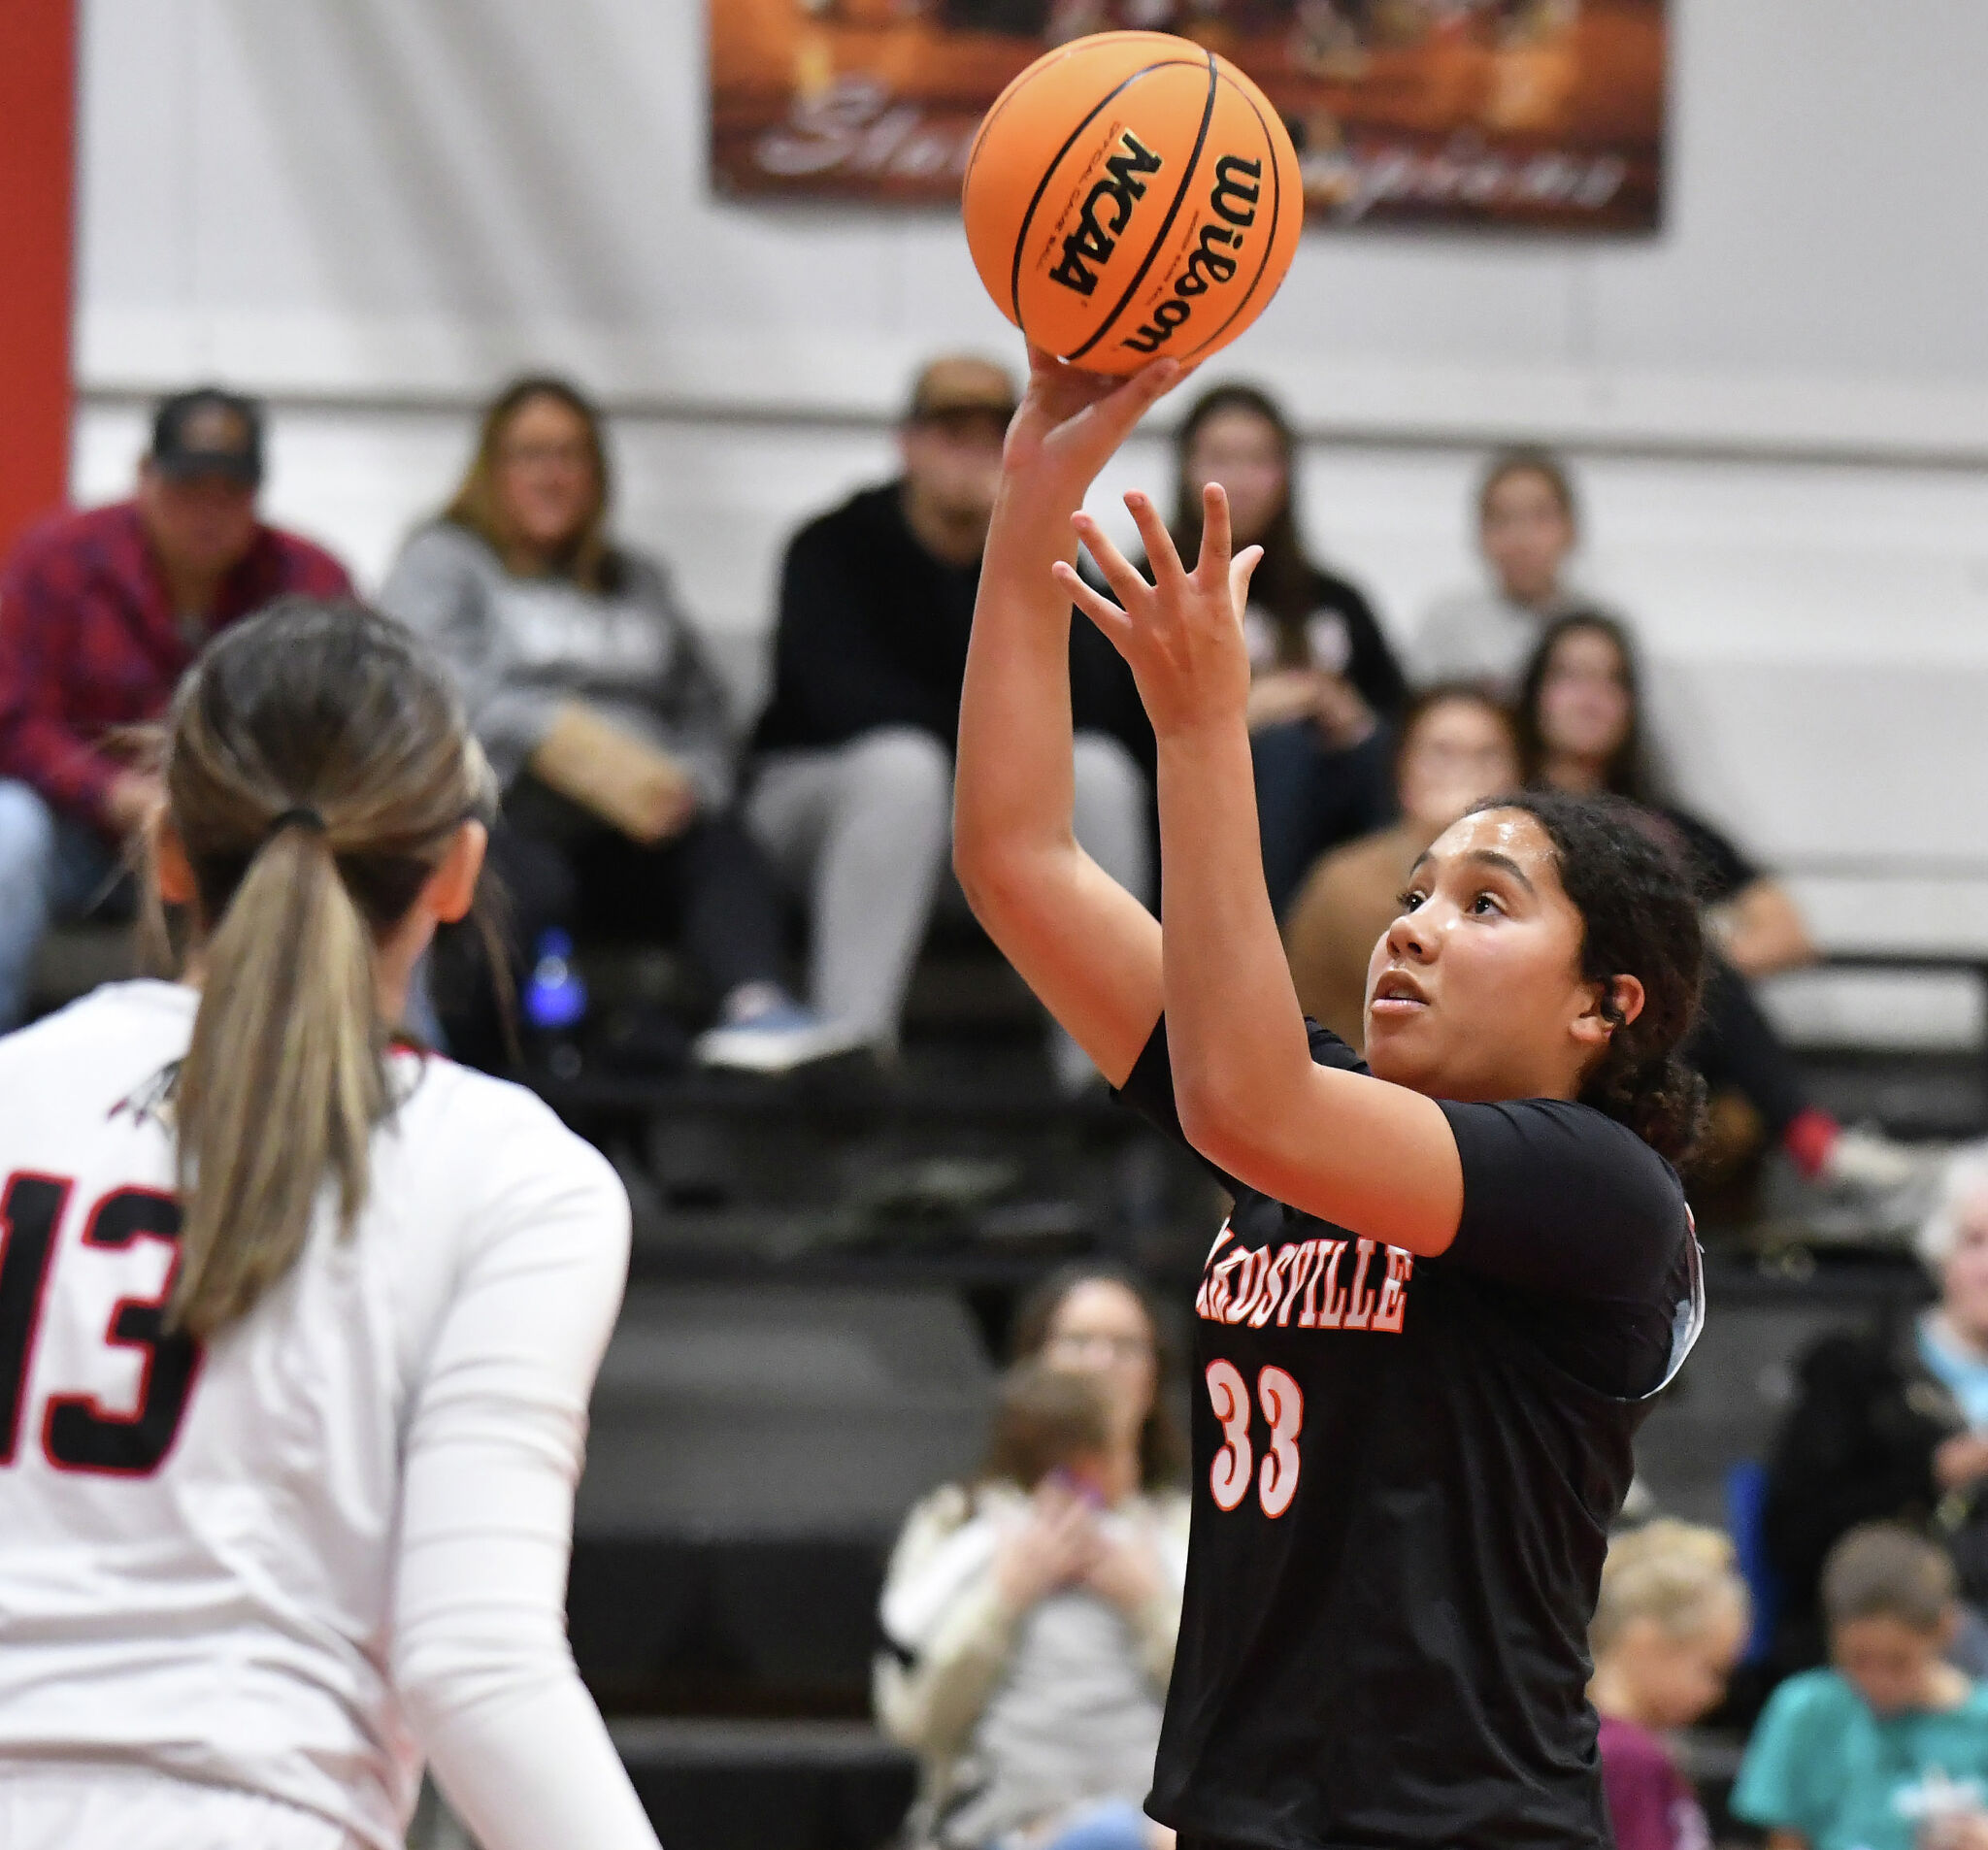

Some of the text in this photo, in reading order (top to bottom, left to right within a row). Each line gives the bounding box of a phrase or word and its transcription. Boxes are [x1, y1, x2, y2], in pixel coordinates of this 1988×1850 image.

[1048, 127, 1162, 295] NCAA
[1120, 153, 1262, 353] Wilson
[0, 1172, 206, 1479] 13
[1206, 1358, 1304, 1519] 33
